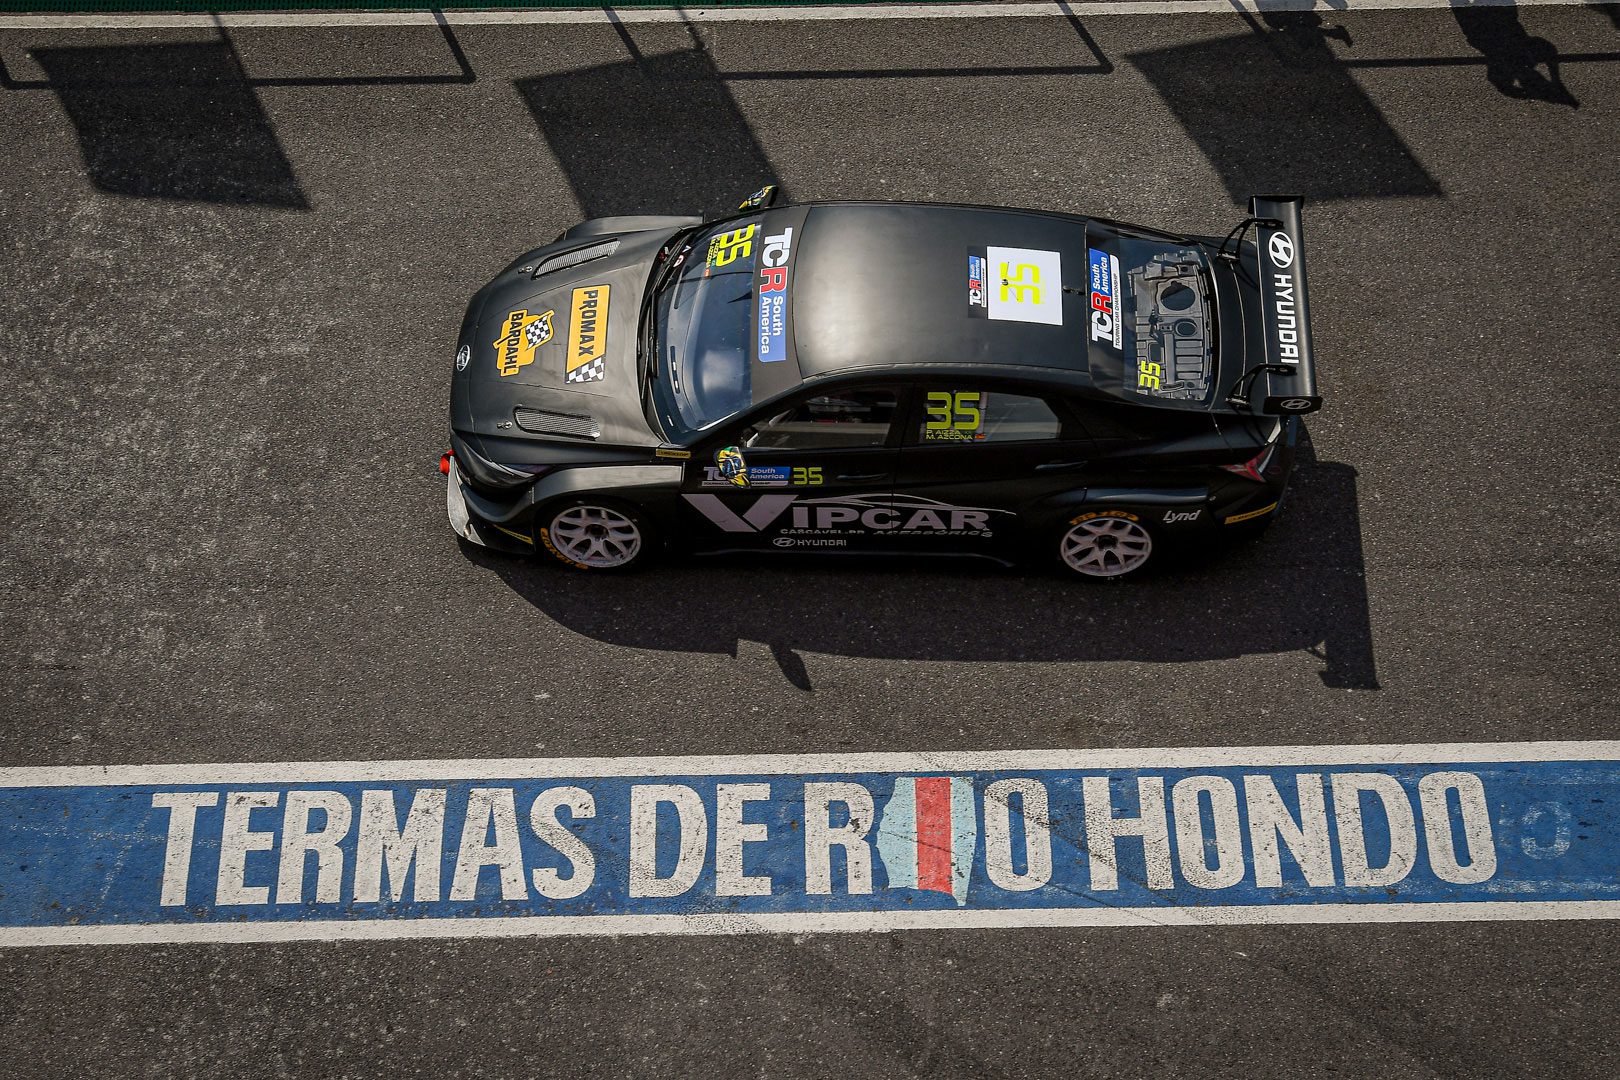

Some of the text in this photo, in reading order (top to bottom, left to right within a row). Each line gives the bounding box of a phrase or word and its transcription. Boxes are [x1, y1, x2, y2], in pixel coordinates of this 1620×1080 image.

[716, 224, 755, 267] 35
[759, 227, 793, 294] TCR
[969, 279, 982, 306] TCR
[999, 262, 1040, 305] 35
[1091, 264, 1100, 289] South
[1100, 256, 1109, 293] America
[578, 289, 599, 357] PROMAX
[761, 296, 772, 354] America
[772, 296, 784, 336] South
[1090, 292, 1112, 342] TCR
[1274, 274, 1299, 364] HYUNDAI
[501, 311, 523, 374] BARDAHL
[1139, 360, 1161, 390] 35
[926, 391, 981, 430] 35
[793, 467, 824, 485] 35
[1163, 510, 1201, 523] Lynd
[152, 785, 597, 907] TERMAS
[628, 782, 772, 899] DE
[1083, 770, 1498, 892] HONDO
